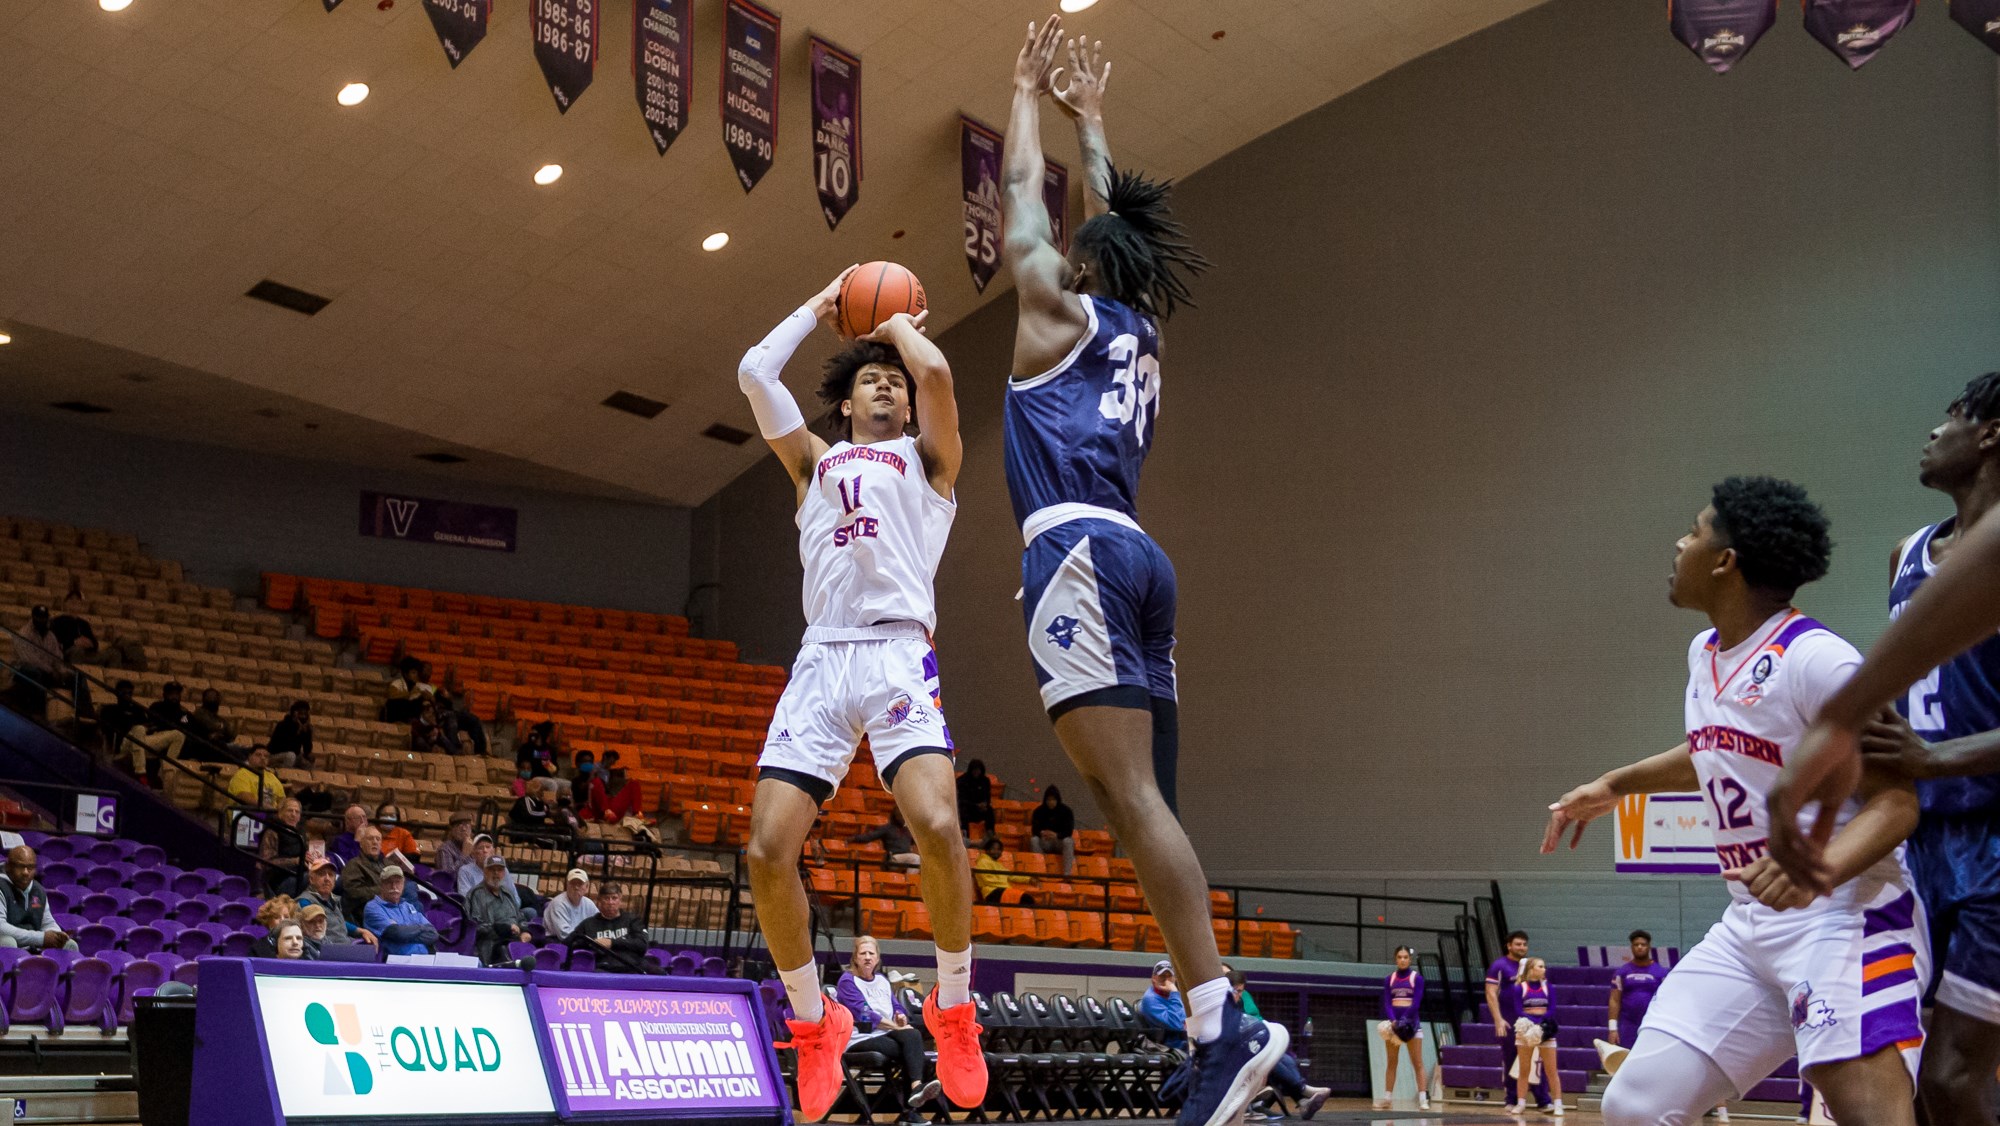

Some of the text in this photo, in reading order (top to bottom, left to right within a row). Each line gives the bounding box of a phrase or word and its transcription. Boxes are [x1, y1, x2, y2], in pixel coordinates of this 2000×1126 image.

[433, 0, 477, 22] 03-04
[538, 0, 591, 38] 1985-86
[650, 6, 677, 28] ASSISTS
[538, 21, 591, 63] 1986-87
[643, 17, 680, 43] CHAMPION
[444, 38, 460, 60] NSU
[644, 50, 680, 78] DOBIN
[731, 62, 768, 88] CHAMPION
[647, 72, 678, 93] 2001-02
[741, 85, 757, 102] PAM
[646, 88, 679, 114] 2002-03
[727, 91, 770, 124] HUDSON
[645, 104, 678, 131] 2003-04
[725, 123, 772, 161] 1989-90
[817, 130, 849, 155] BANKS
[818, 152, 850, 198] 10
[965, 221, 996, 264] 25
[818, 447, 908, 491] ORTHWESTERN
[837, 473, 864, 516] 11
[386, 498, 419, 536] V
[1706, 776, 1754, 830] 12
[98, 805, 114, 830] G
[1716, 838, 1770, 870] STAT
[597, 927, 628, 940] DEMON
[558, 997, 736, 1017] YOU'RE ALWAYS A DEMON
[640, 1021, 731, 1035] NORTHWESTERN STATE
[371, 1025, 392, 1071] THE
[390, 1026, 502, 1072] QUAD
[603, 1021, 755, 1077] Alumni
[615, 1077, 762, 1100] ASSOCIATION
